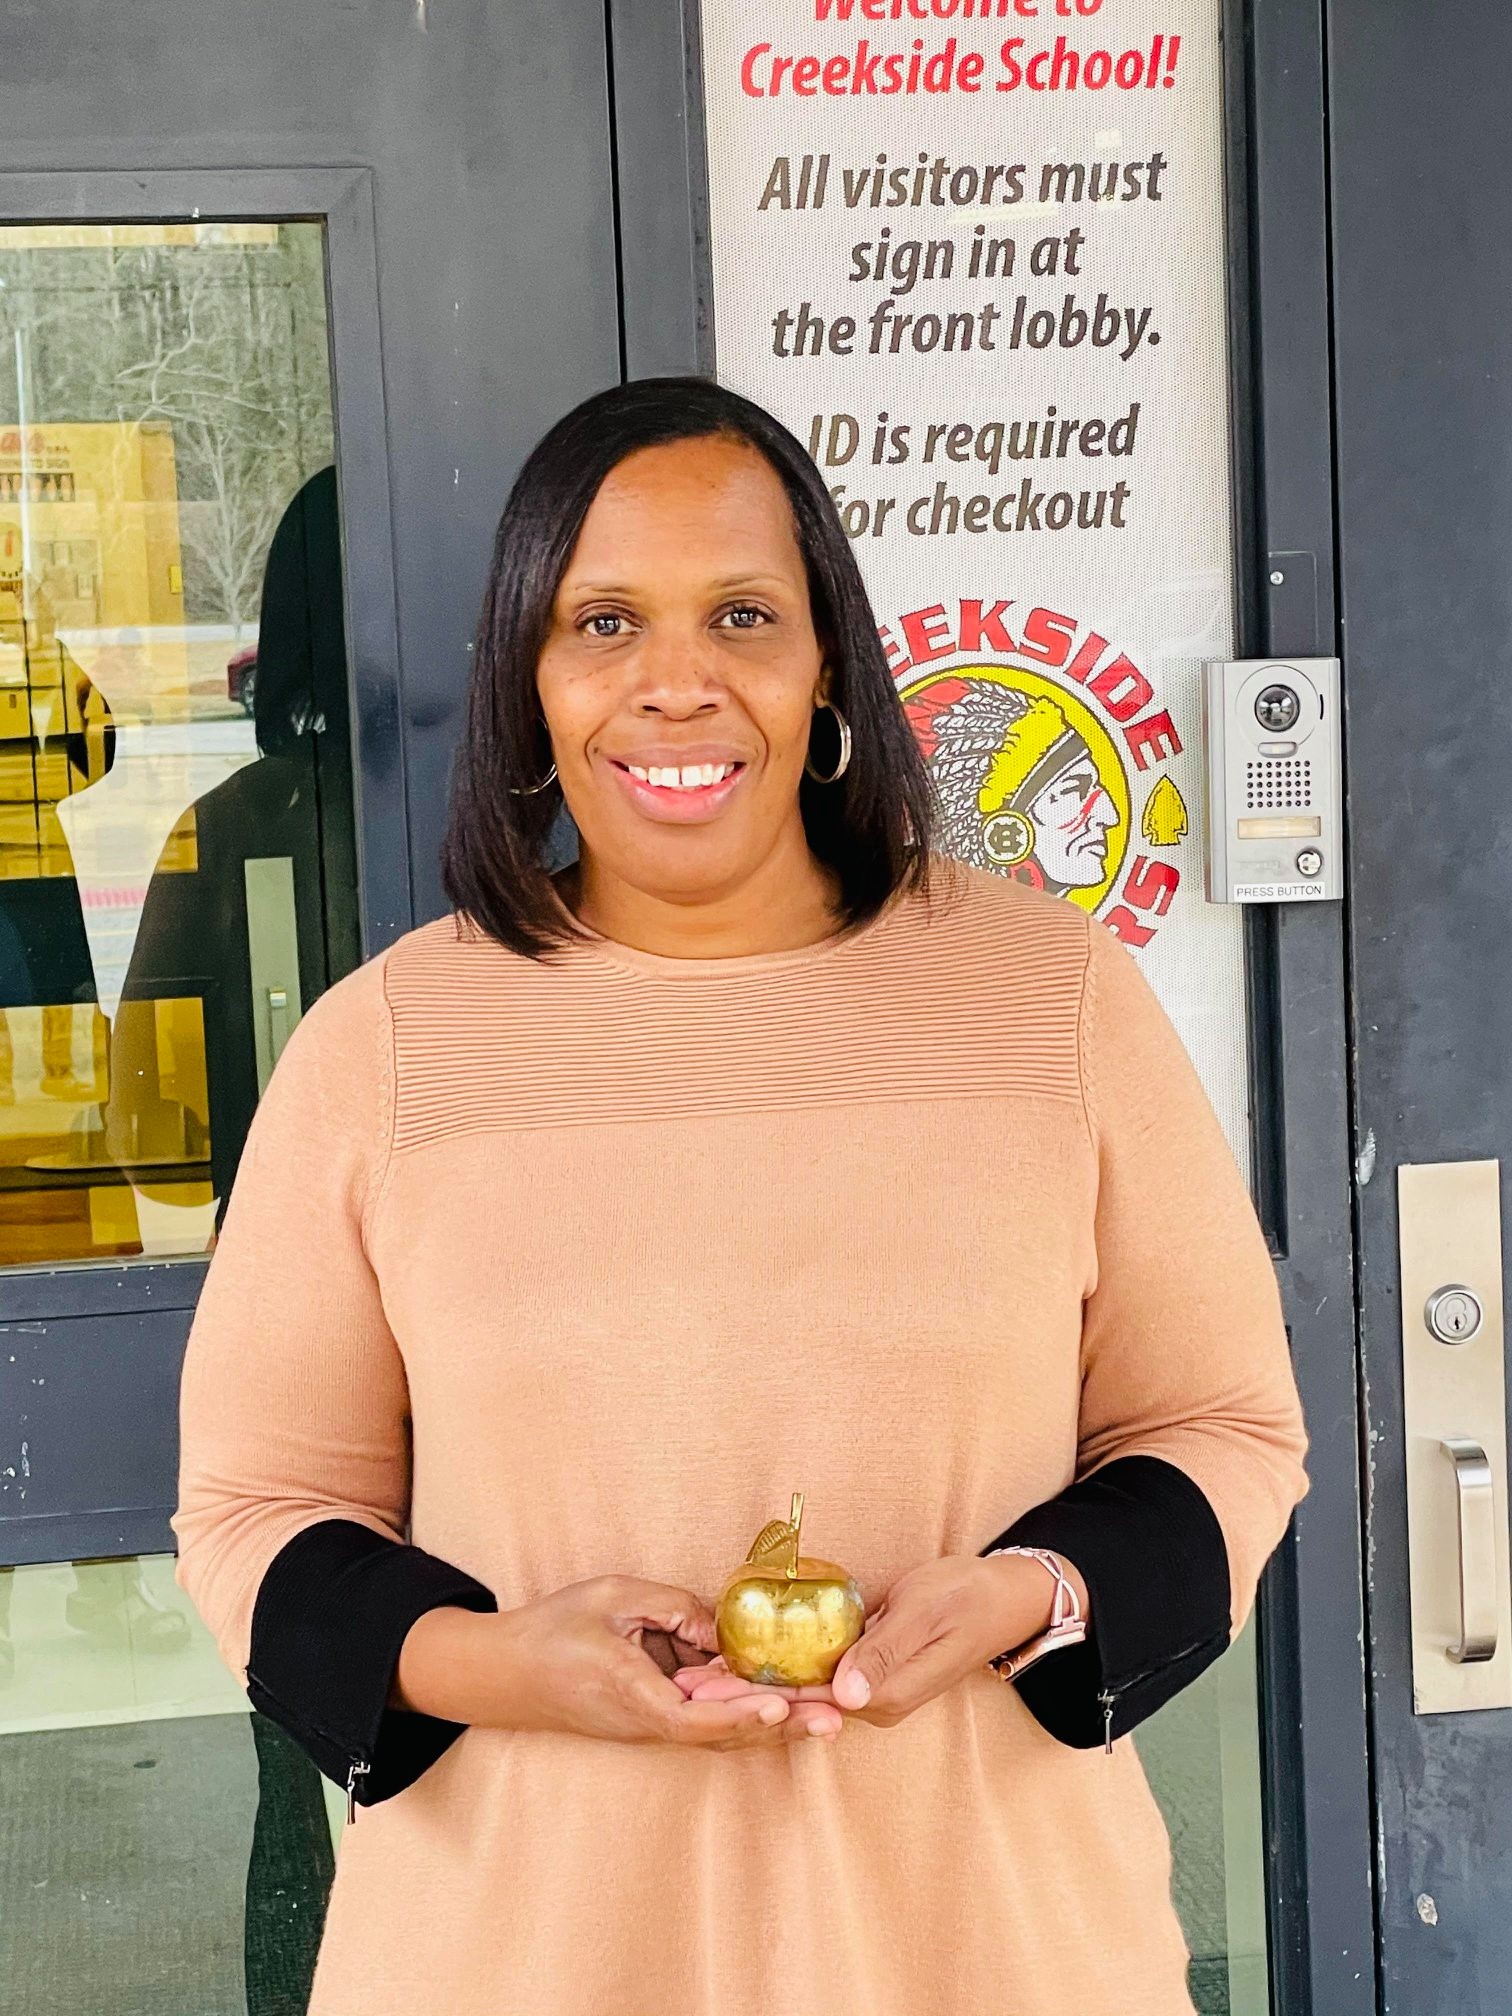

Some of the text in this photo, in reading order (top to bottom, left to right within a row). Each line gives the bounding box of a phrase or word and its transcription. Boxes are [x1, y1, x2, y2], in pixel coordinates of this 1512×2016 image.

[740, 34, 1182, 98] Creekside School!
[758, 152, 1168, 211] All visitors must
[848, 225, 1085, 296] sign in at
[771, 293, 1161, 362] the front lobby.
[808, 402, 1141, 475] ID is required
[907, 478, 1131, 536] checkout
[1236, 885, 1323, 897] PRESS BUTTON
